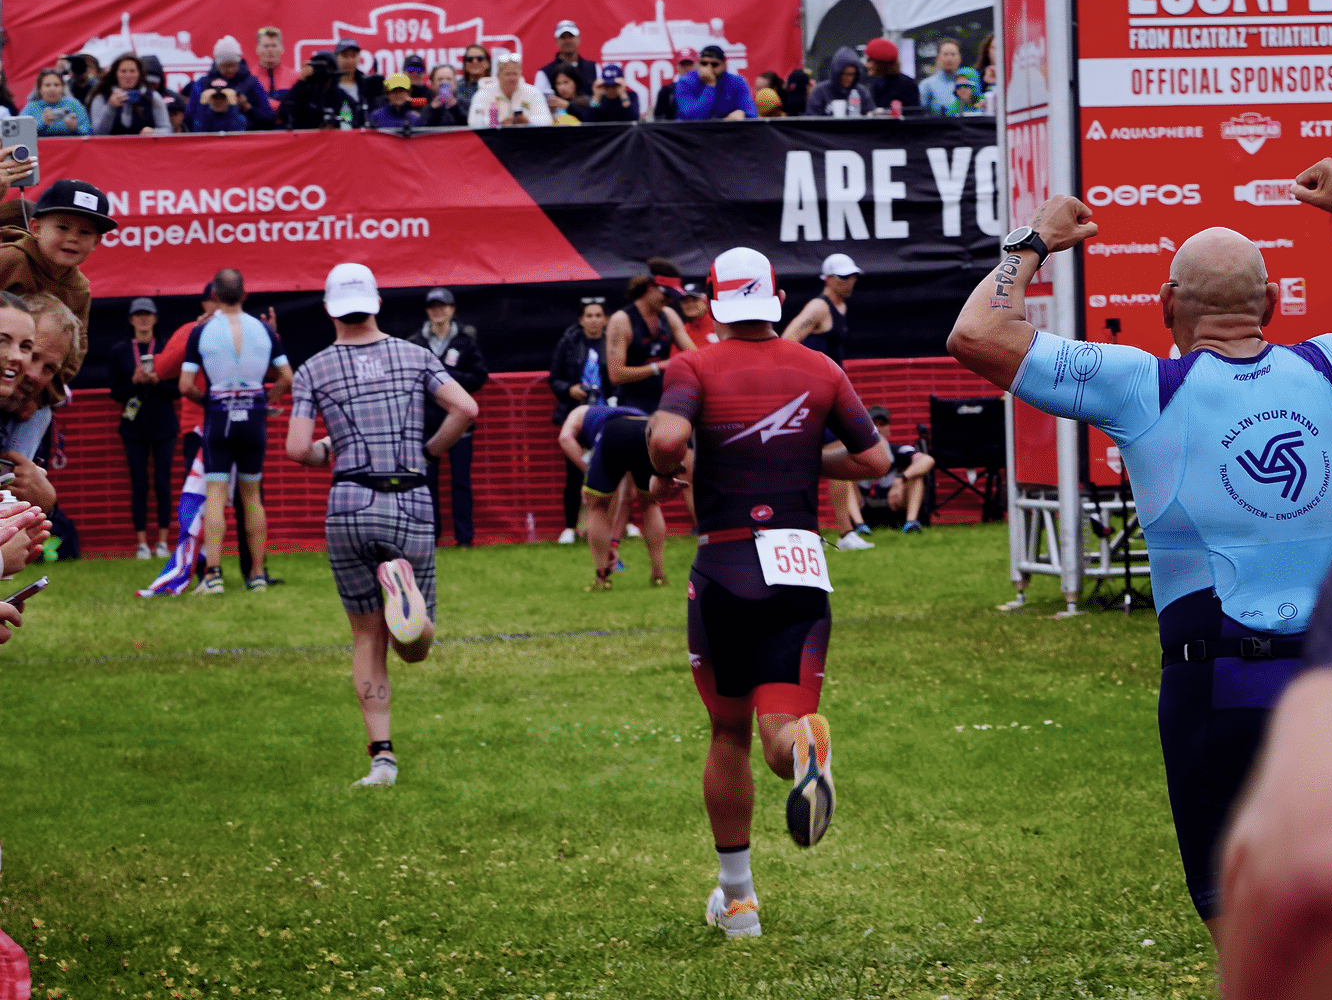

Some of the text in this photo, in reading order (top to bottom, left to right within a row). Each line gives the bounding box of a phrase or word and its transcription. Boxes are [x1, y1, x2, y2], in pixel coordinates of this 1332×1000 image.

[384, 18, 433, 43] 1894
[1128, 27, 1170, 50] FROM
[1172, 27, 1248, 50] ALCATRAZ
[1131, 68, 1223, 95] OFFICIAL
[1110, 126, 1203, 139] AQUASPHERE
[139, 184, 327, 216] FRANCISCO
[780, 149, 909, 242] ARE
[926, 146, 1001, 237] YO
[99, 214, 430, 252] capeAlcatrazTri.com
[1221, 409, 1319, 449] ALL IN YOUR MIND
[1219, 450, 1331, 521] TRAINING SYSTEM ENDURANCE COMMUNITY
[773, 546, 821, 577] 595
